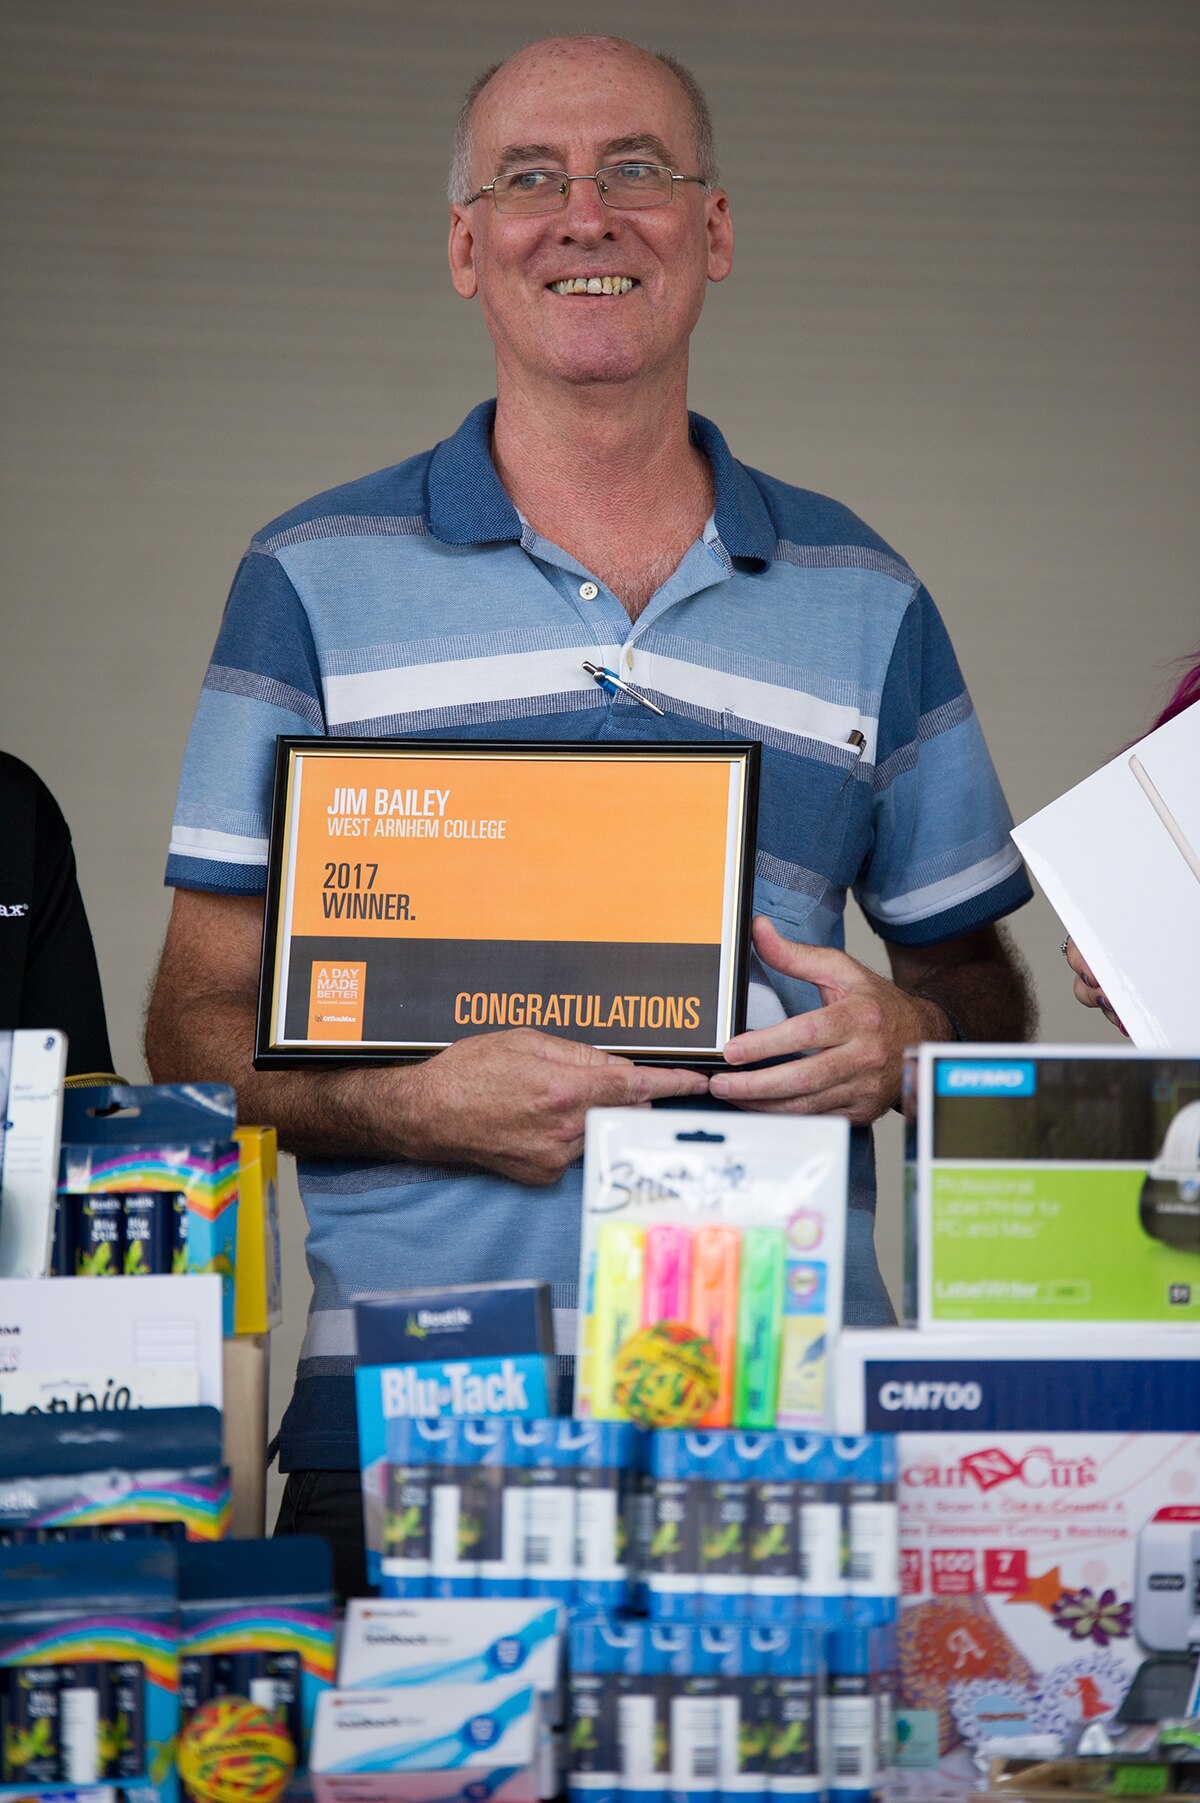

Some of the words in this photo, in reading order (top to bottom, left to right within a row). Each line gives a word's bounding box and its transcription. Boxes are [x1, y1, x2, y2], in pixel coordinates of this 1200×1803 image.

[327, 788, 368, 815] JIM
[374, 788, 451, 817] BAILEY
[327, 817, 371, 837] WEST
[373, 818, 439, 838] ARNHEM
[443, 819, 507, 839] COLLEGE
[323, 862, 379, 890] 2017
[322, 892, 416, 921] WINNER.
[317, 979, 359, 990] MADE
[318, 967, 329, 979] A
[331, 968, 360, 979] DAY
[317, 989, 358, 999] BETTER
[454, 992, 701, 1029] CONGRATULATIONS
[947, 1068, 1025, 1088] DYMO
[879, 1381, 981, 1411] CM700
[902, 1465, 966, 1489] can
[932, 1554, 976, 1573] 100
[996, 1553, 1014, 1573] 7
